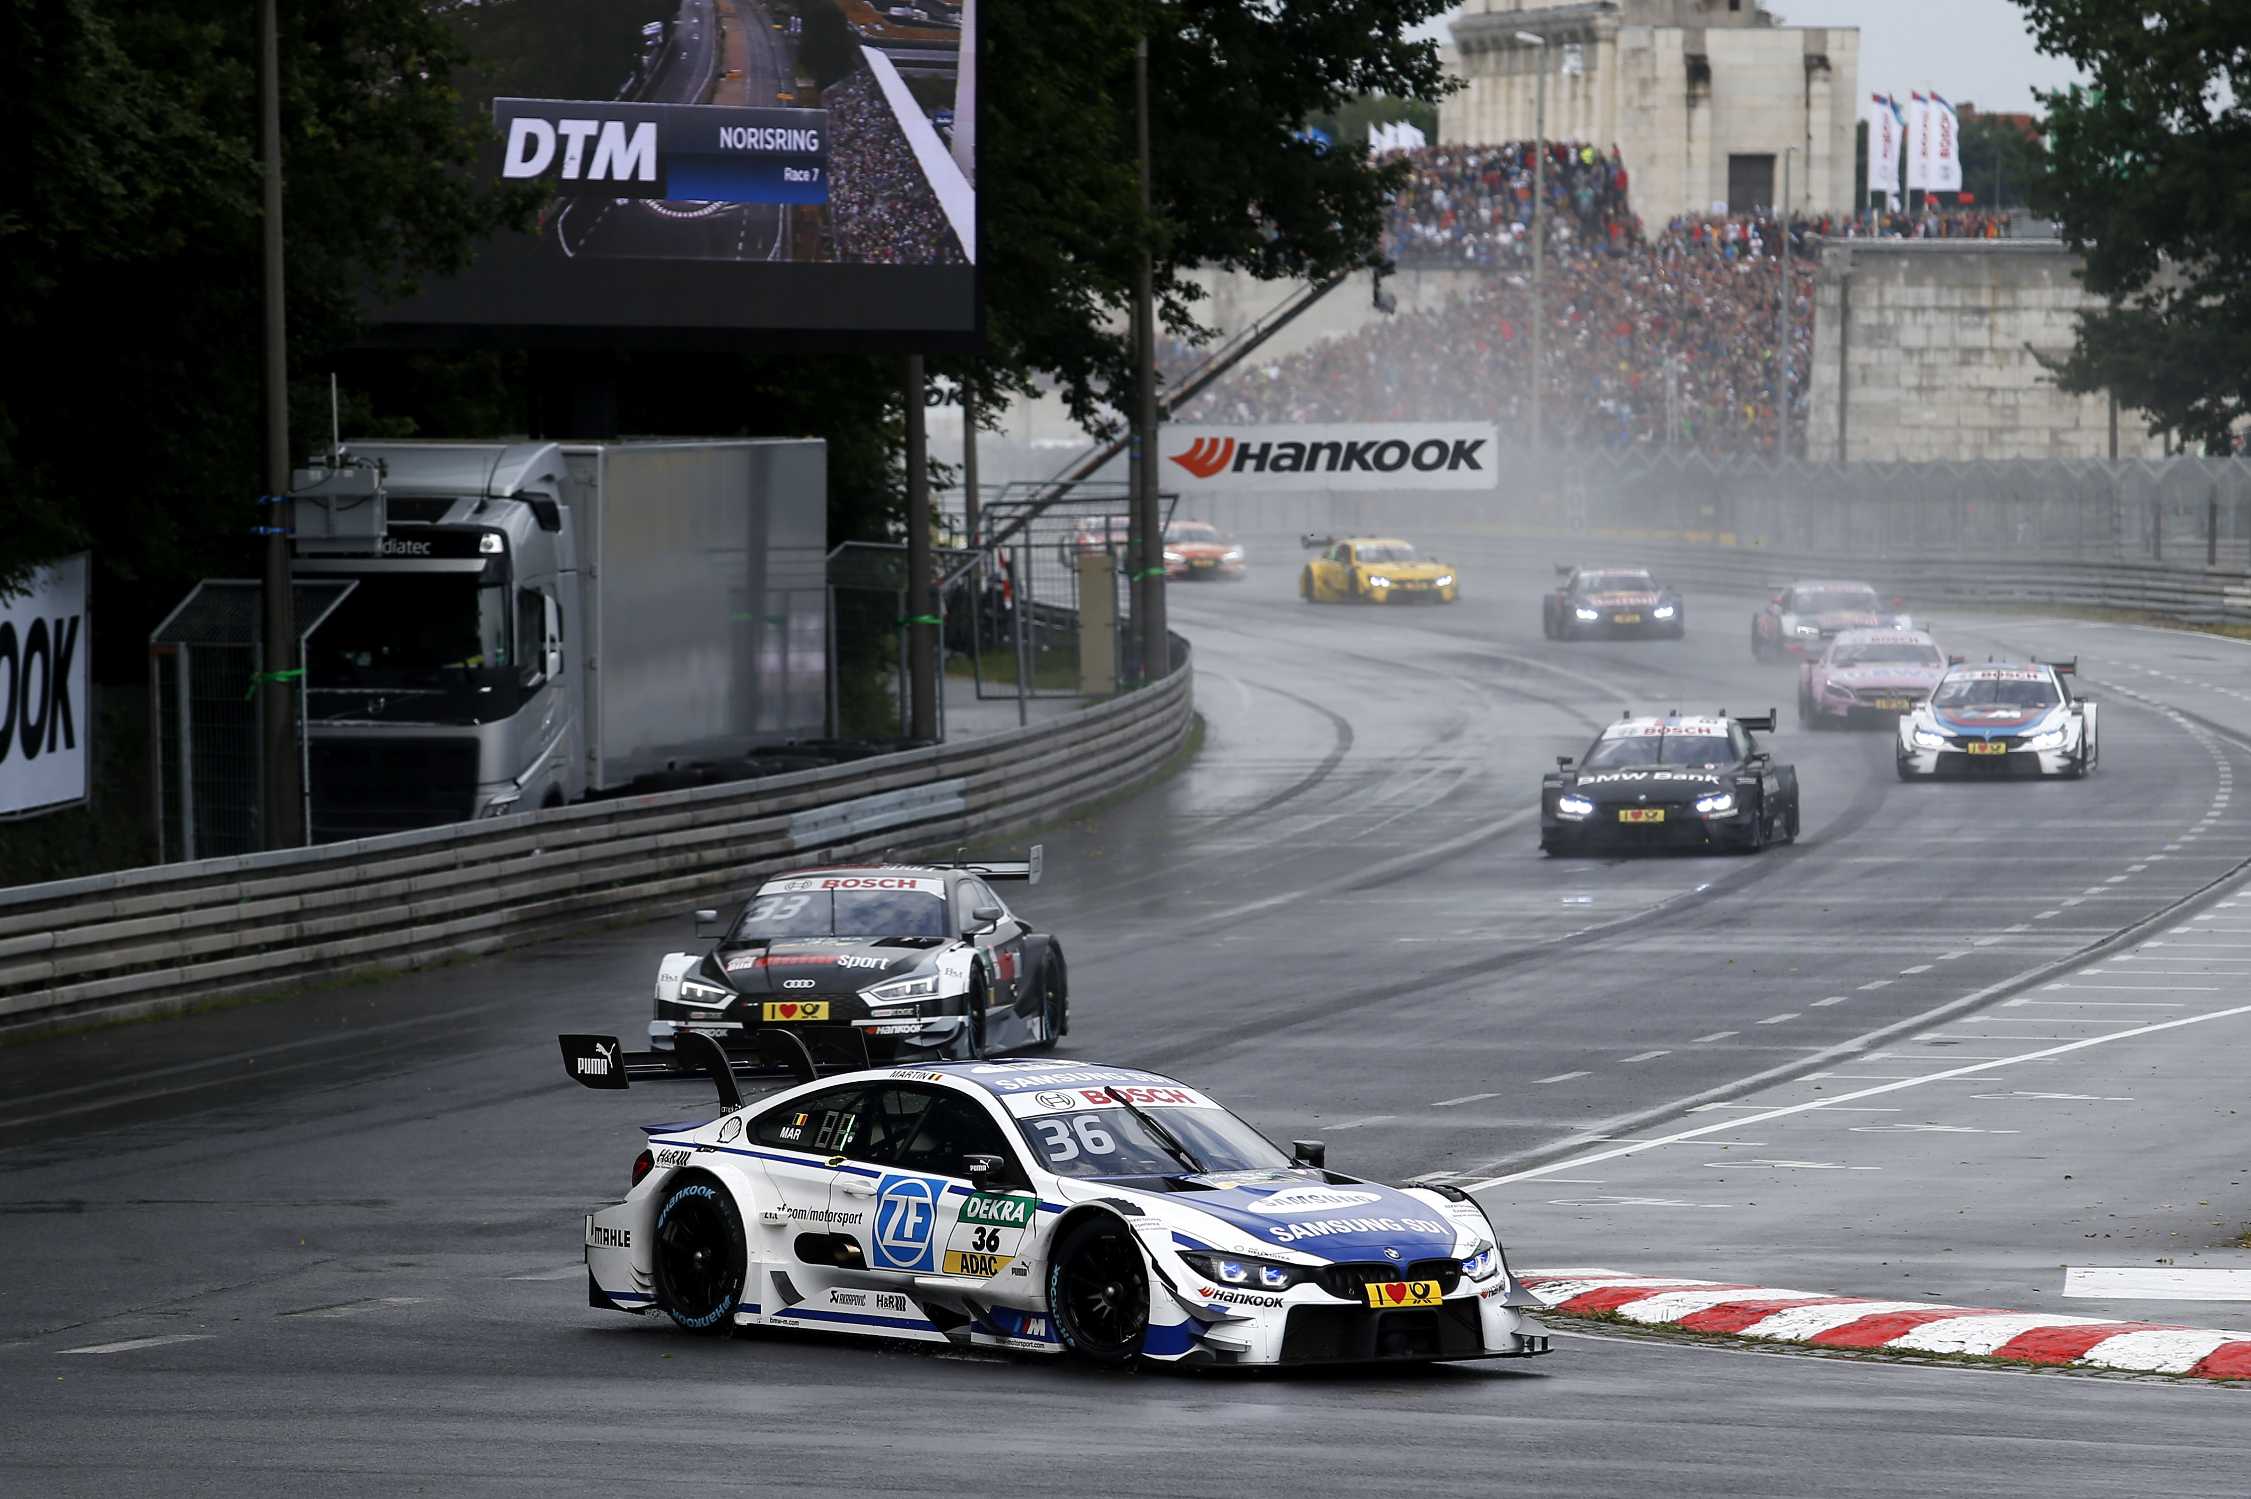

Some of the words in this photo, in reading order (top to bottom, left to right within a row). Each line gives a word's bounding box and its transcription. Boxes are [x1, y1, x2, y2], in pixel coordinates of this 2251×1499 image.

[719, 126, 819, 152] NORISRING
[502, 117, 657, 182] DTM
[784, 167, 809, 183] Race
[811, 168, 819, 183] 7
[1232, 438, 1487, 473] HanKOOK
[1644, 727, 1712, 736] BOSCH
[1577, 772, 1648, 786] BMW
[1653, 771, 1720, 785] Bank
[821, 879, 917, 889] BOSCH
[749, 895, 811, 923] 33
[577, 1057, 608, 1075] PUMA
[889, 1070, 928, 1081] MARTIN
[995, 1072, 1125, 1090] SAMSUNG
[1081, 1087, 1197, 1105] BOSCH
[780, 1127, 801, 1140] MAR
[1034, 1115, 1117, 1162] 36
[967, 1197, 1026, 1223] DEKRA
[882, 1194, 930, 1250] ZF
[1269, 1216, 1400, 1242] SAMSUNG
[1401, 1218, 1450, 1236] SDI
[594, 1226, 631, 1248] MAHLE
[972, 1226, 1000, 1253] 36
[960, 1253, 998, 1277] ADAC
[1011, 1267, 1028, 1277] PUMA
[876, 1293, 896, 1309] H&R
